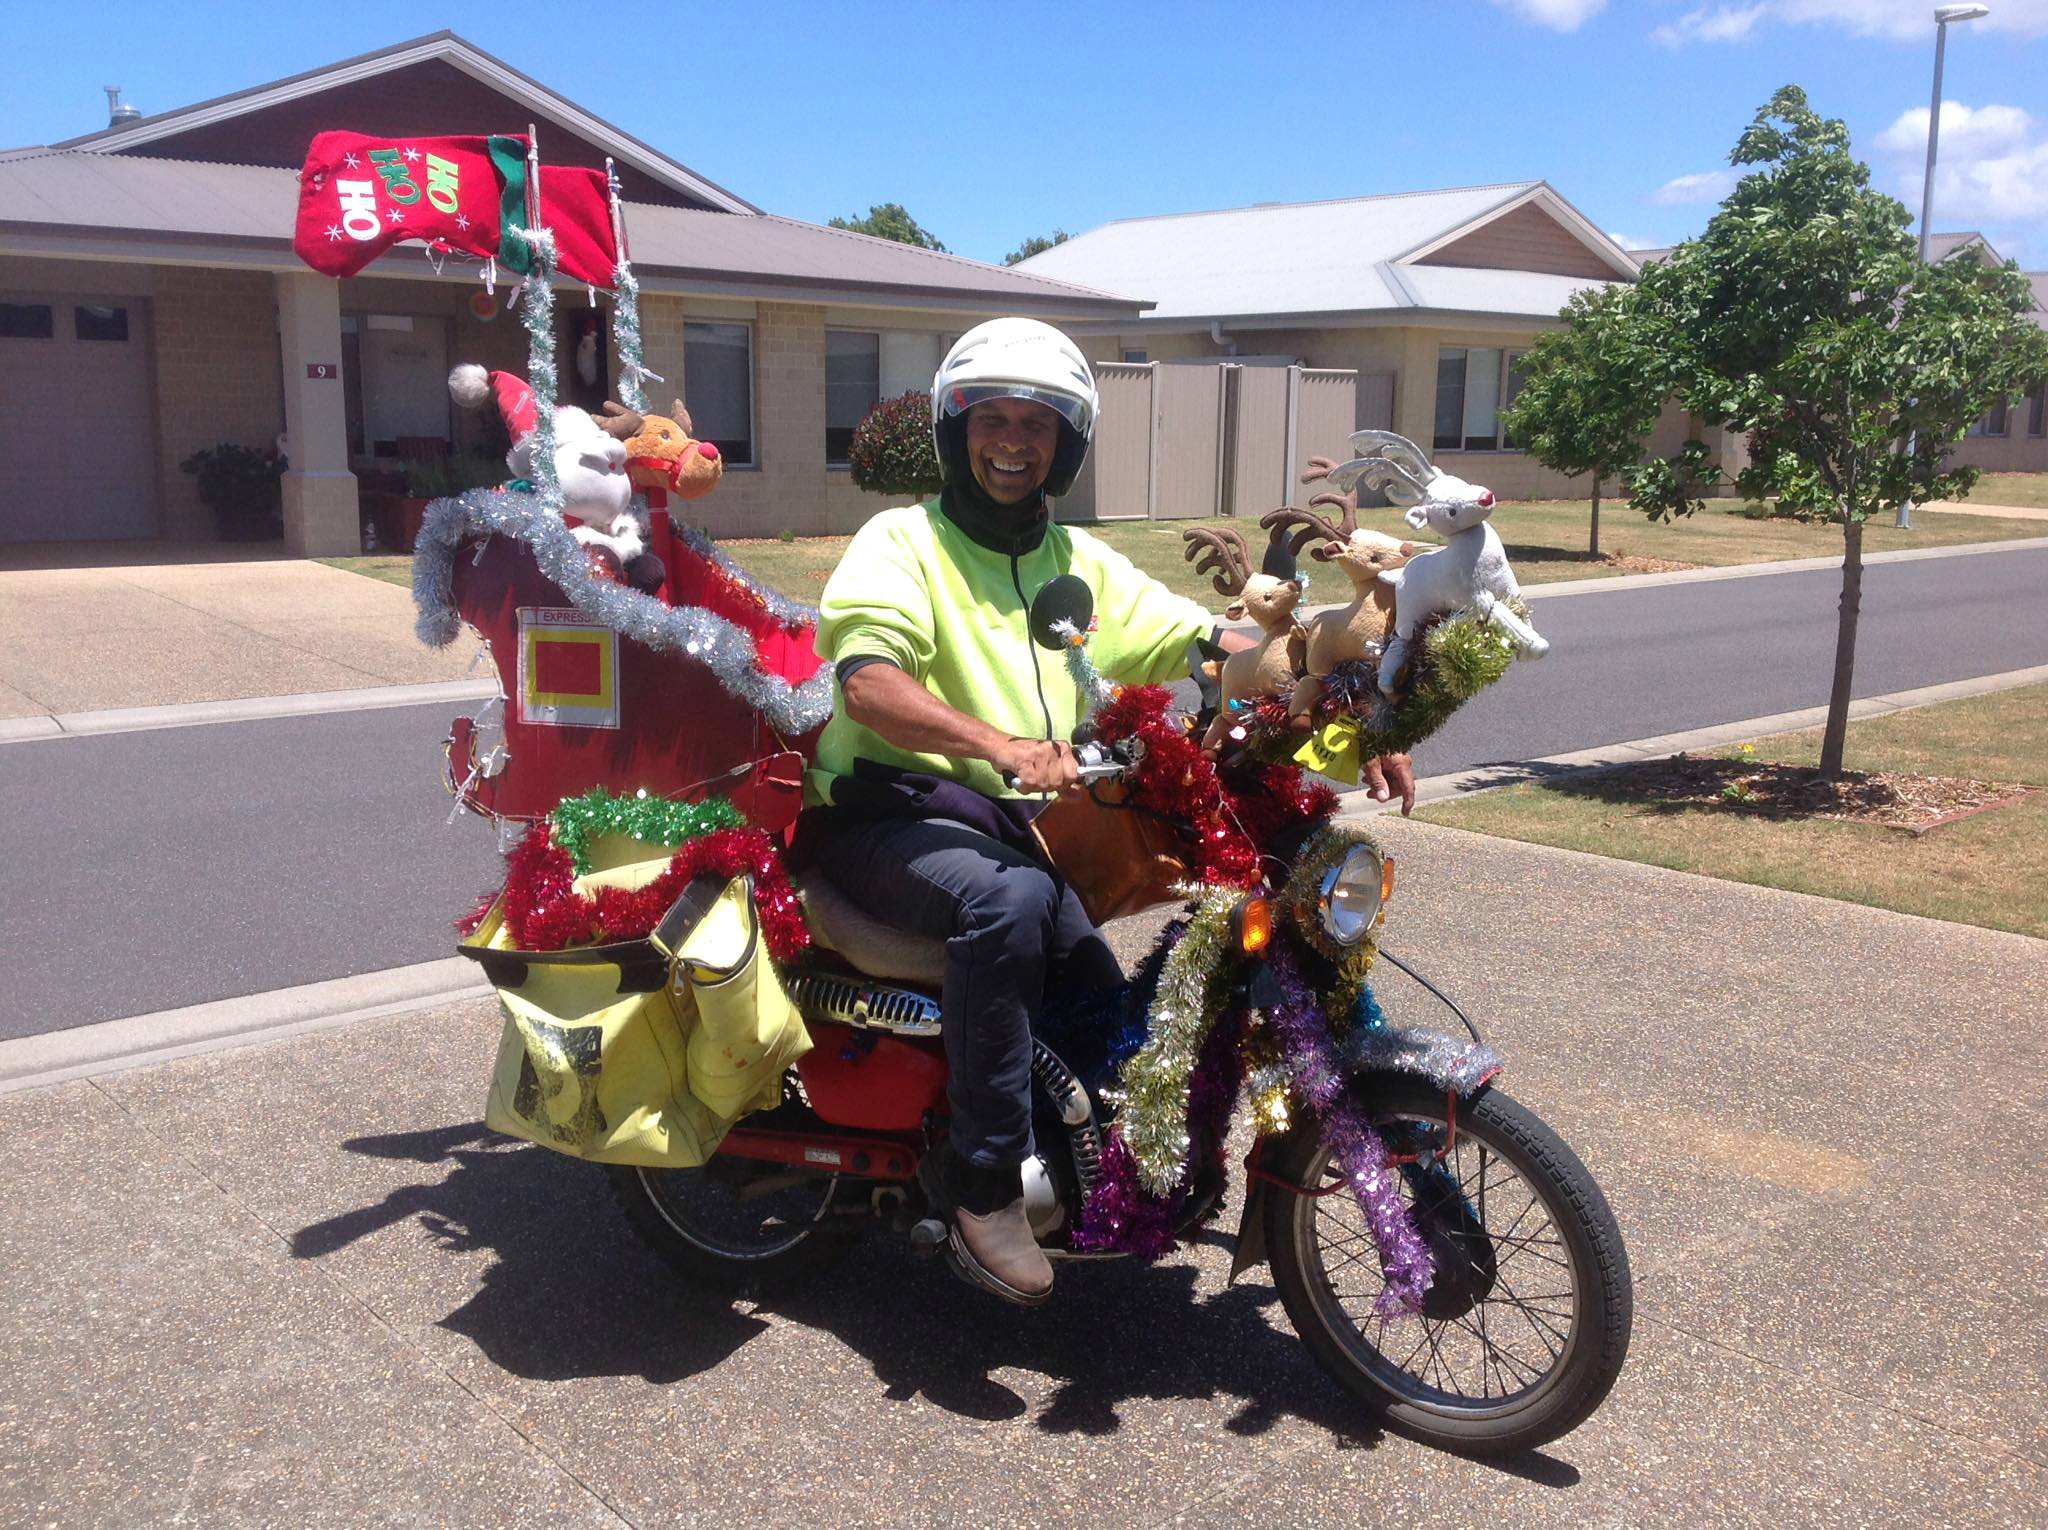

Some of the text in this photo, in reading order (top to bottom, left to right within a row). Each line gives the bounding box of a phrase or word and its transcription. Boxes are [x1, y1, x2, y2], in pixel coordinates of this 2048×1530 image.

[368, 148, 421, 205] HO
[425, 152, 459, 214] HO
[336, 179, 381, 241] HO
[317, 365, 326, 378] 9
